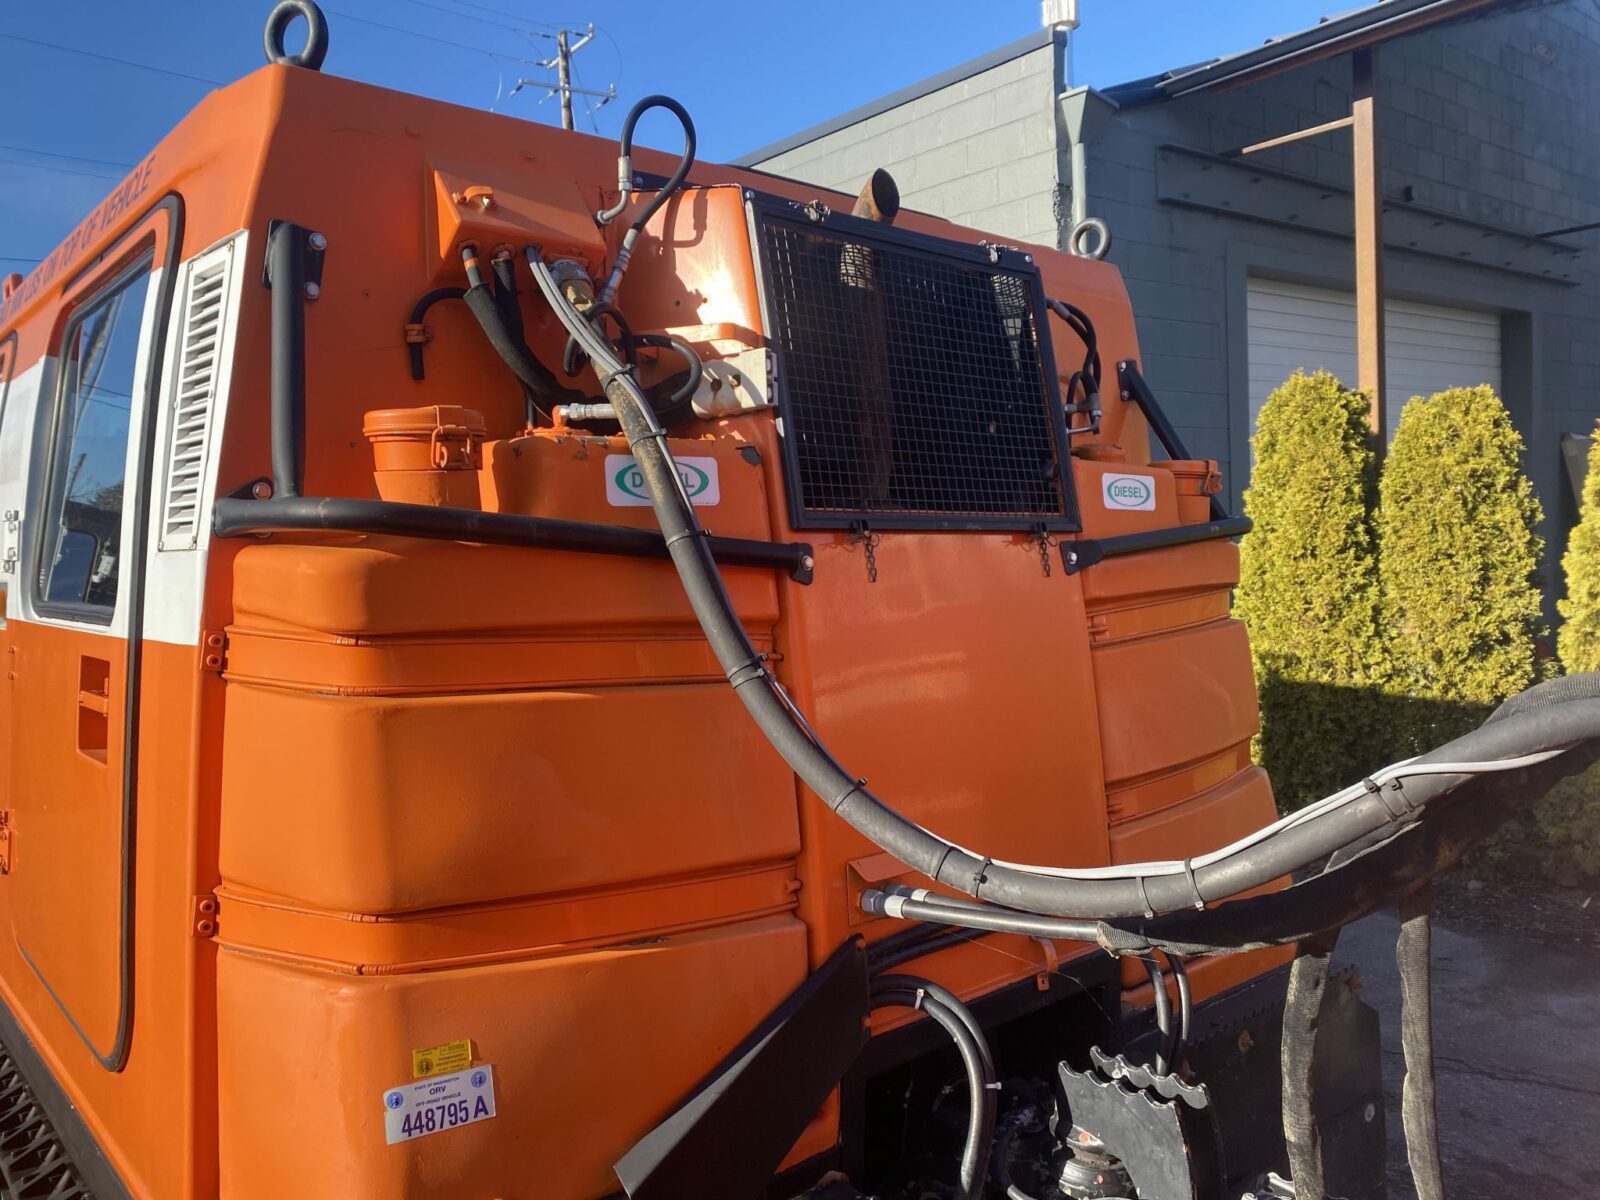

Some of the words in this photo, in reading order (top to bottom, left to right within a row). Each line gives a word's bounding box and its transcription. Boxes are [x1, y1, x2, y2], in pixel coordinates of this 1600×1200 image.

[100, 153, 157, 231] VEHICLE
[1114, 485, 1144, 499] DIESEL
[429, 1085, 447, 1096] ORV
[441, 1091, 461, 1101] VEHICLE
[401, 1099, 469, 1138] 448795
[473, 1095, 489, 1119] A
